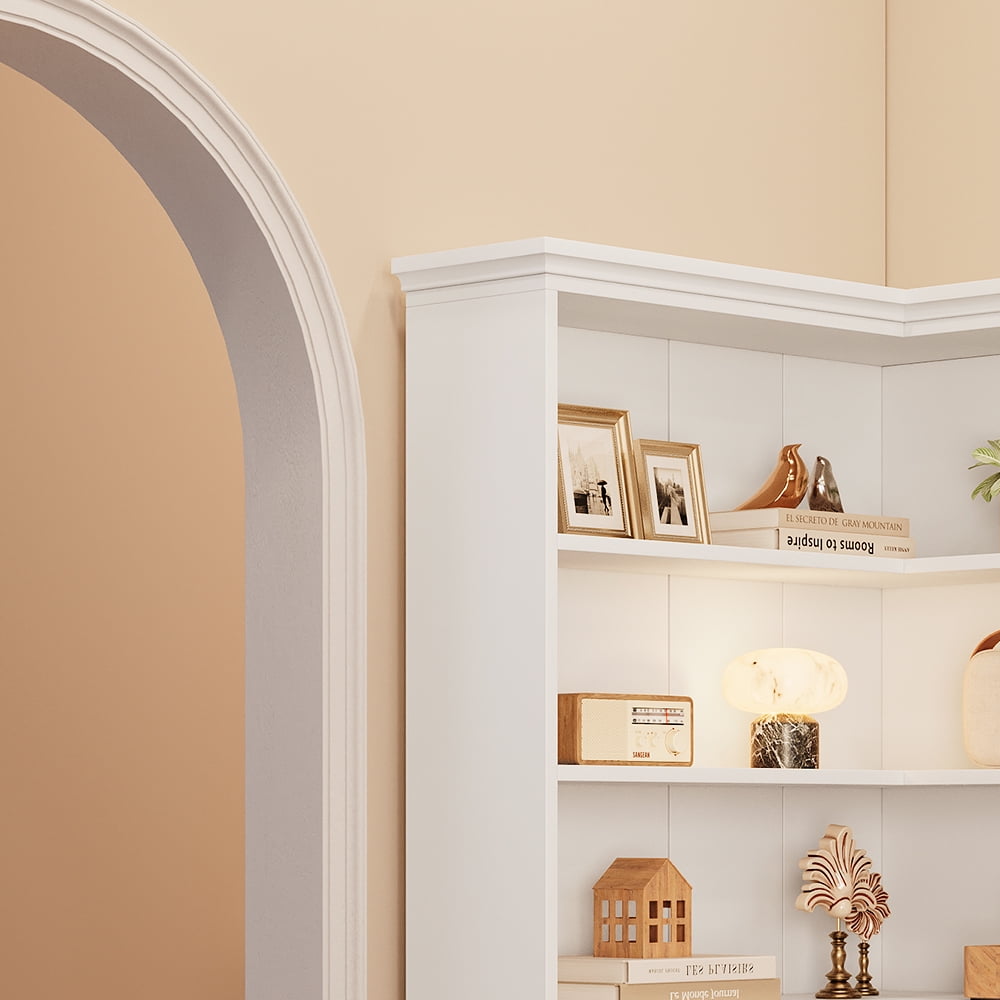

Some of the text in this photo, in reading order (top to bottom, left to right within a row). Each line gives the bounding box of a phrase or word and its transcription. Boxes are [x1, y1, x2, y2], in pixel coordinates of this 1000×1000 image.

[786, 513, 903, 532] EL SECRETO DE GRAY MOUNTAIN
[787, 533, 875, 555] Rooms to Inspire
